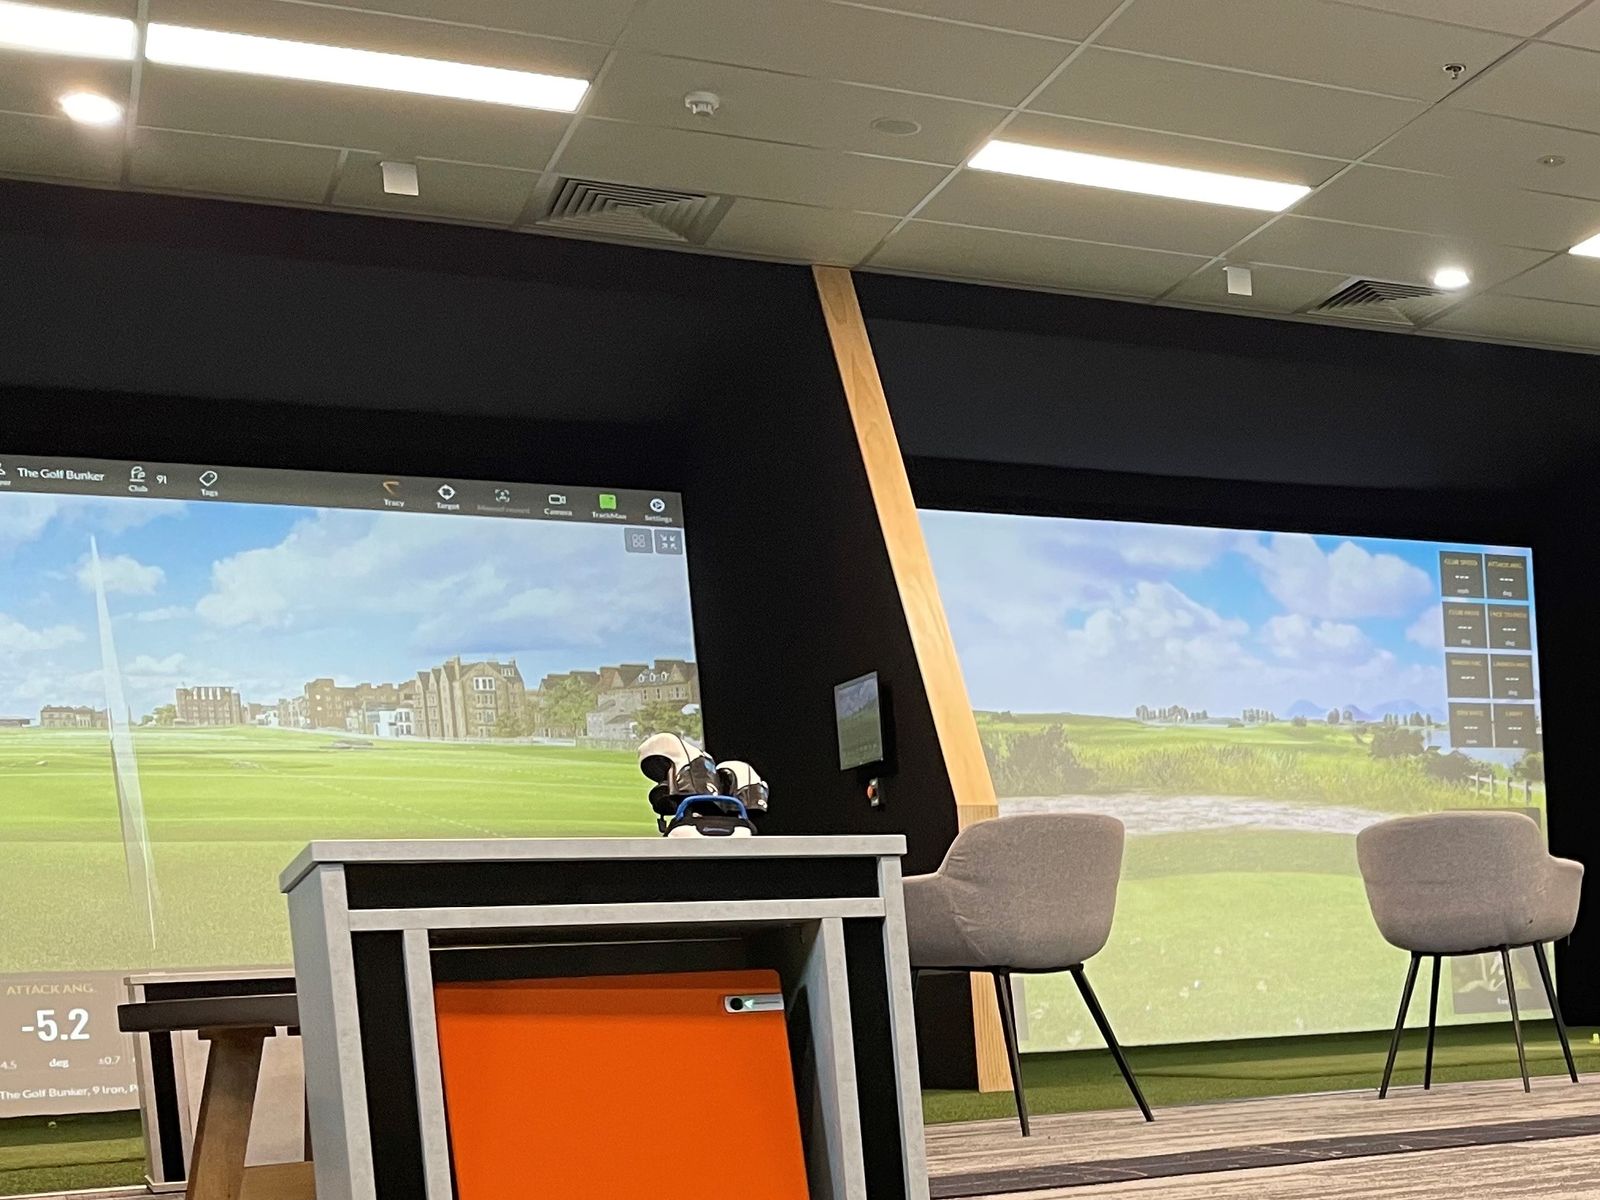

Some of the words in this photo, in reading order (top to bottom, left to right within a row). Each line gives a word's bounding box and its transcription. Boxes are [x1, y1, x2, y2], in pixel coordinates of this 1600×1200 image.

[17, 468, 39, 478] The
[40, 469, 64, 479] Golf
[66, 470, 105, 481] Bunker
[6, 983, 60, 996] ATTACK
[21, 1007, 91, 1042] -5.2
[48, 1058, 70, 1068] deg
[0, 1091, 20, 1100] The
[22, 1088, 46, 1099] Golf
[92, 1086, 101, 1094] 9
